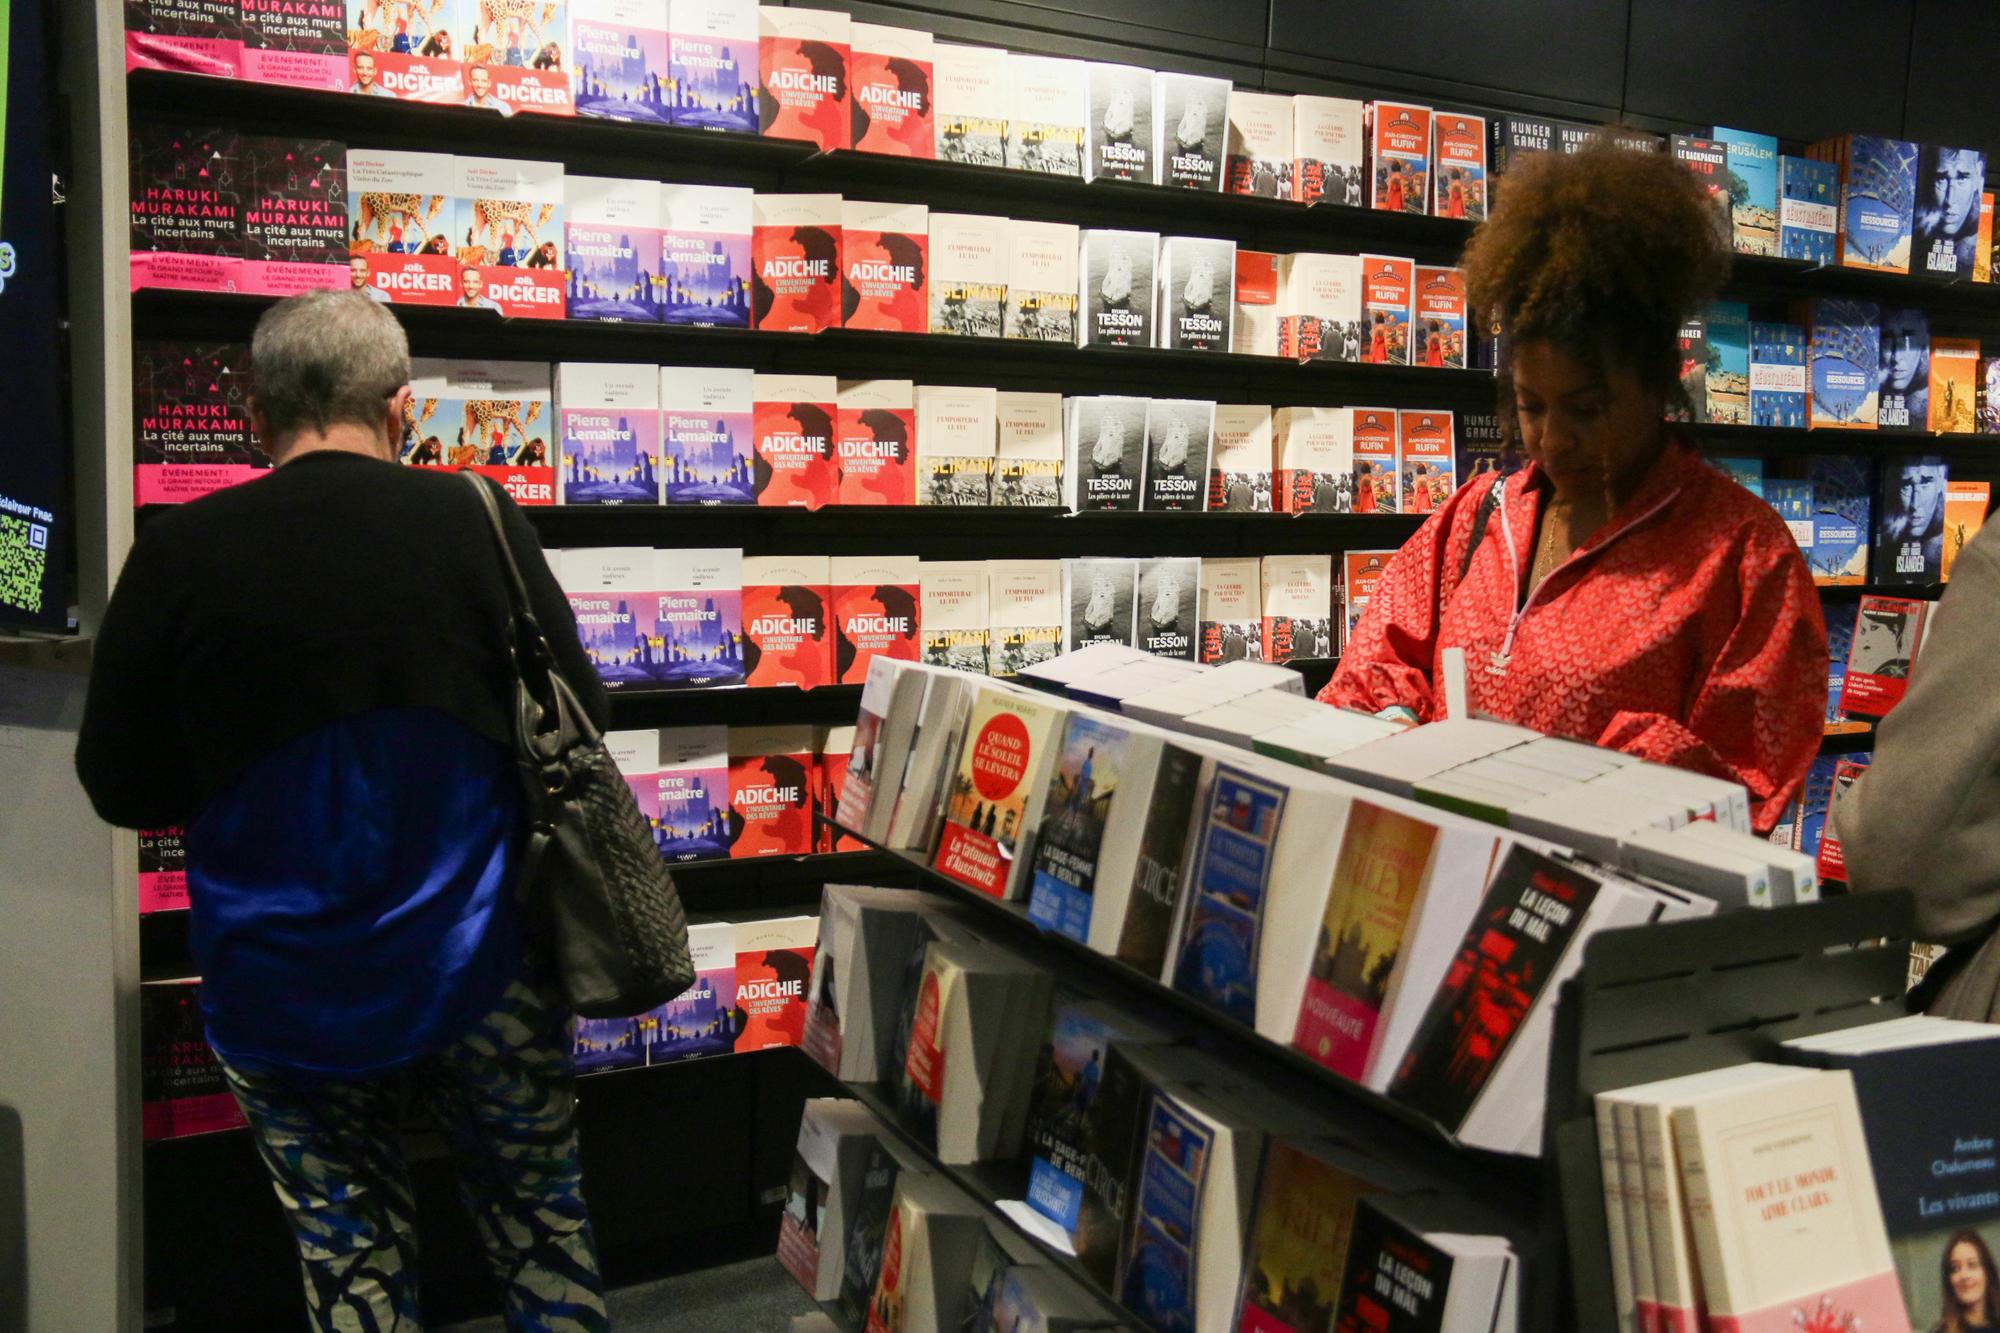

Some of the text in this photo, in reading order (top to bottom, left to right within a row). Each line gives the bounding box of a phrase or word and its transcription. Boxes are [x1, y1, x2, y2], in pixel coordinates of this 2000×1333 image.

[151, 5, 214, 23] incertains
[242, 11, 342, 29] La cité aux murs
[262, 23, 322, 38] incertains
[577, 25, 618, 42] Pierre
[671, 38, 713, 54] Pierre
[383, 72, 459, 92] DICKER
[768, 70, 837, 94] ADICHIE
[496, 83, 567, 104] DICKER
[860, 86, 922, 110] ADICHIE
[1511, 121, 1550, 137] HUNGER
[1391, 138, 1416, 150] RUFIN
[1514, 135, 1549, 150] GAMES
[1100, 145, 1145, 163] TESSON
[1449, 147, 1473, 158] RUFIN
[1727, 143, 1773, 160] ERUSALEM
[1171, 156, 1214, 173] TESSON
[147, 188, 219, 202] HARUKI
[131, 202, 235, 218] MURAKAMI
[261, 198, 329, 213] HARUKI
[132, 214, 235, 229] La cité aux murs
[246, 212, 344, 228] MURAKAMI
[1860, 215, 1899, 228] RESSOURCES
[154, 225, 215, 239] incertains
[247, 223, 344, 239] La cité aux murs
[568, 228, 612, 243] Pierre
[267, 235, 325, 248] incertains
[663, 235, 705, 250] Pierre
[403, 262, 425, 273] JOËL
[763, 259, 828, 277] ADICHIE
[1927, 252, 1957, 273] ISLANDER
[376, 272, 452, 291] DICKER
[513, 275, 535, 286] JOËL
[850, 264, 915, 283] ADICHIE
[488, 284, 560, 304] DICKER
[1375, 290, 1399, 301] RUFIN
[1429, 299, 1452, 310] RUFIN
[1097, 313, 1142, 326] TESSON
[1179, 318, 1222, 332] TESSON
[1826, 374, 1865, 385] RESSOURCES
[158, 404, 229, 417] HARUKI
[1879, 407, 1909, 426] ISLANDER
[143, 418, 245, 431] MURAKAMI
[567, 414, 610, 427] Pierre
[669, 416, 708, 429] Pierre
[1463, 415, 1498, 426] HUNGE
[143, 430, 244, 442] La cité aux murs
[1465, 427, 1502, 439] GAMES
[164, 441, 224, 452] incertains
[762, 435, 826, 453] ADICHIE
[838, 439, 899, 457] ADICHIE
[1360, 440, 1384, 451] RUFIN
[1415, 442, 1440, 452] RUFIN
[507, 474, 527, 483] JOËL
[1087, 479, 1133, 491] TESSON
[1154, 480, 1197, 491] TESSON
[503, 483, 551, 500] CKER
[0, 495, 53, 523] claireur Fnac
[1819, 529, 1857, 539] RESSOURCES
[1896, 555, 1925, 573] ISLANDER
[569, 598, 611, 610] Pierre
[659, 596, 697, 609] Pierre
[576, 611, 630, 623] emaitre
[846, 617, 908, 633] ADICHIE
[751, 617, 815, 634] ADICHIE
[1147, 636, 1188, 648] TESSON
[988, 730, 1019, 750] QUAND
[975, 756, 985, 768] SE
[978, 743, 1022, 767] LE SOLEIL
[659, 777, 684, 788] erre
[659, 787, 704, 799] maitre
[734, 786, 798, 805] ADICHIE
[746, 812, 759, 820] DES
[140, 836, 180, 847] La cité
[950, 836, 961, 851] Le
[962, 840, 999, 869] tatoueur
[1044, 843, 1093, 877] LA SAGE-FEMME
[945, 854, 996, 887] d'Auschwitz
[1048, 863, 1082, 887] DE BERLIN
[1519, 887, 1573, 927] LA LEÇON
[1508, 907, 1553, 943] DU MAL
[736, 980, 802, 999] ADICHIE
[749, 1006, 762, 1014] DES
[1305, 995, 1365, 1041] NOUVEAUTÉ
[1954, 1137, 1993, 1153] Ambre
[1932, 1156, 1995, 1176] Chalumeau
[1795, 1167, 1836, 1189] MONDE
[1919, 1190, 2000, 1216] Les vivants
[1378, 1251, 1394, 1274] LA
[1396, 1261, 1432, 1297] LEÇON
[1375, 1272, 1418, 1316] DU MAL
